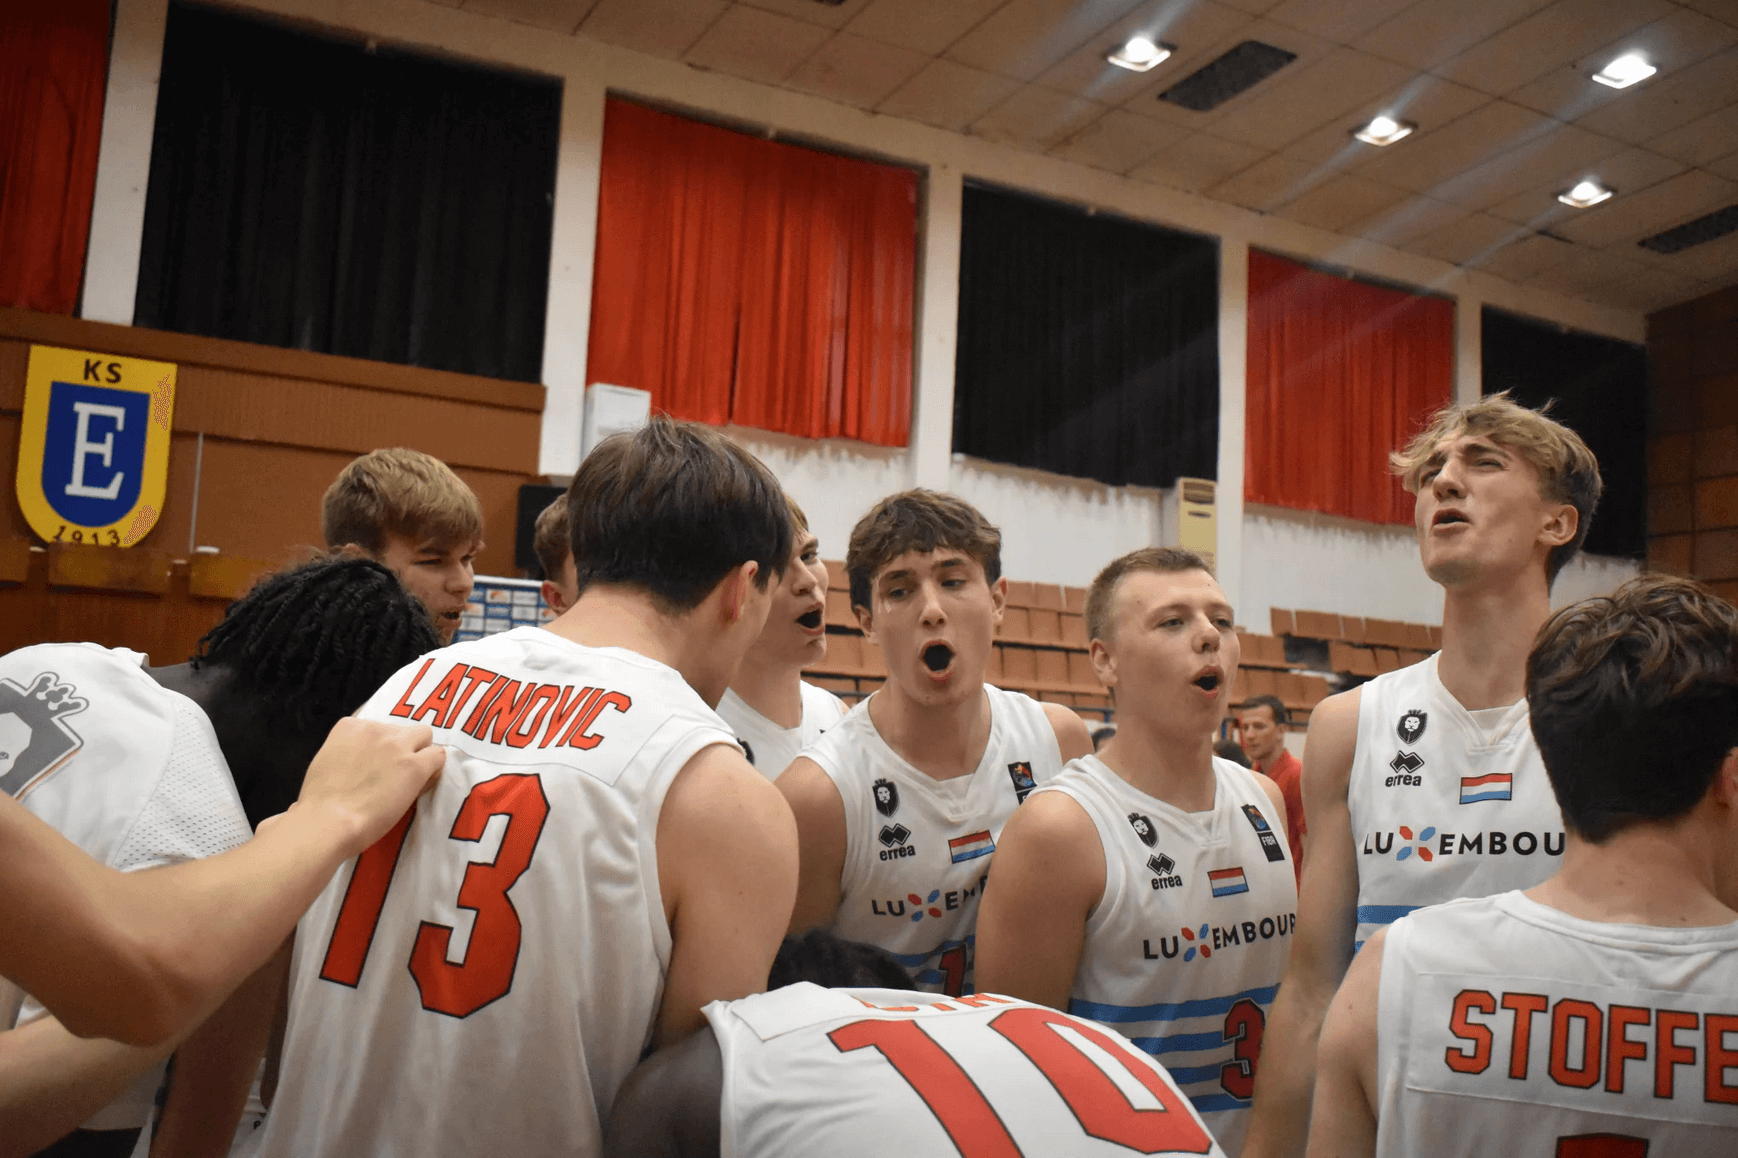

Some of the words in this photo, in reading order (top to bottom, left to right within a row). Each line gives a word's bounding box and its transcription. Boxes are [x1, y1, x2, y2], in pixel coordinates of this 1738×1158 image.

[84, 358, 122, 383] KS
[64, 401, 125, 500] E
[53, 525, 120, 546] 1913
[391, 658, 632, 751] LATINOVIC
[319, 773, 550, 1018] 13
[827, 1008, 1212, 1158] 10
[1221, 999, 1265, 1099] 3
[1445, 989, 1738, 1105] STOFFE
